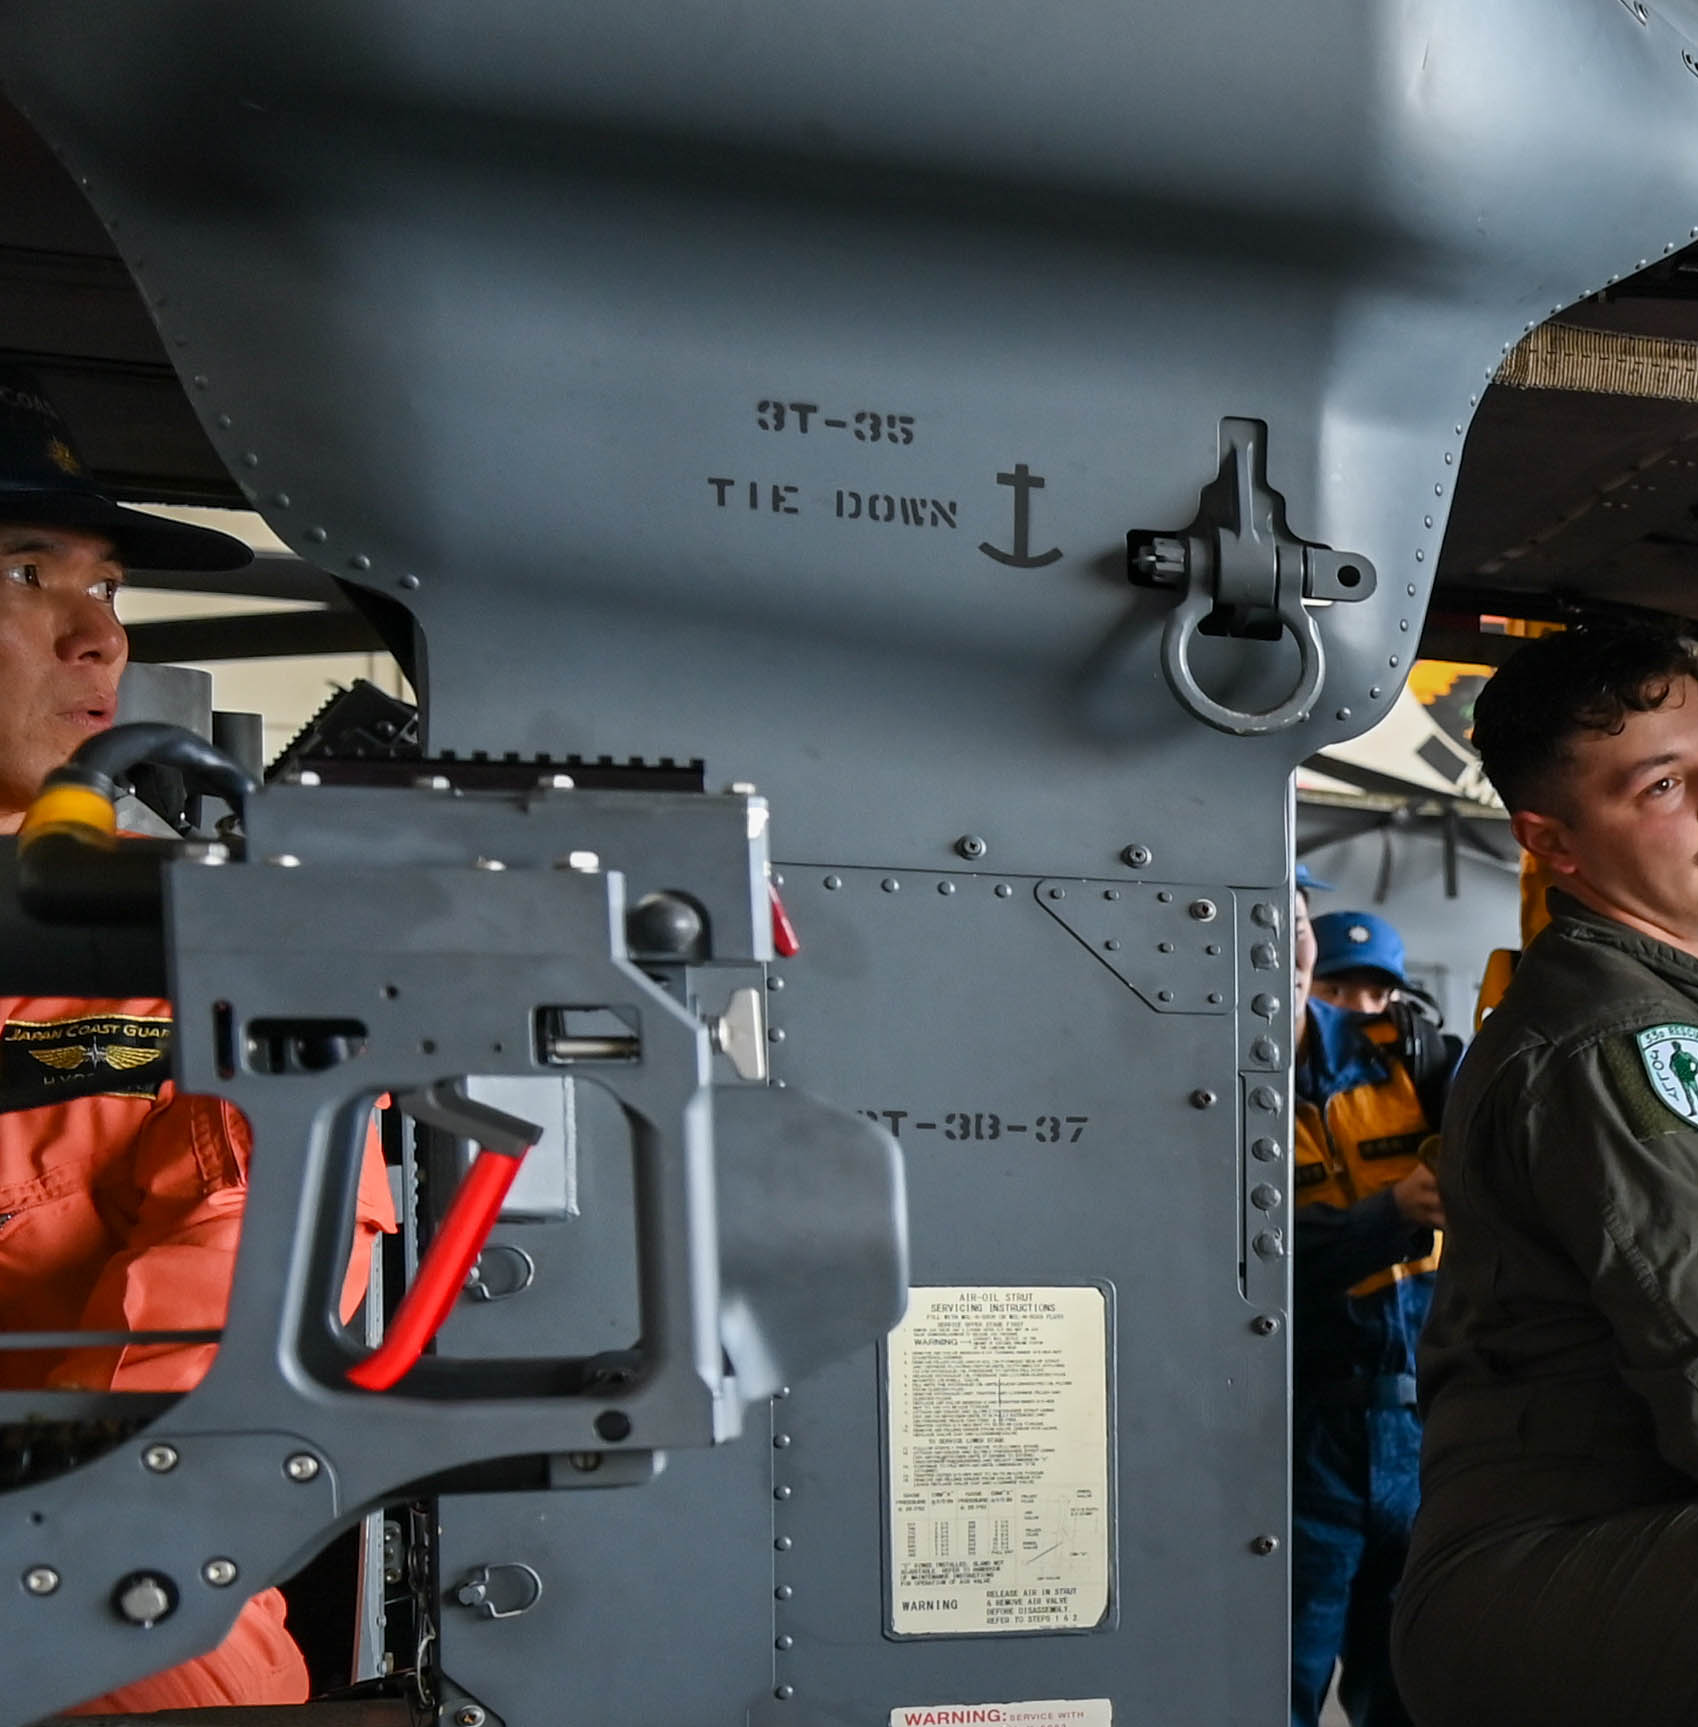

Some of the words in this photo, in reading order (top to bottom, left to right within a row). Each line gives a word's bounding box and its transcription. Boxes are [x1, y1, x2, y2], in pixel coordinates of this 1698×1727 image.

[757, 400, 915, 445] 3T-35
[707, 477, 799, 514] TIE
[836, 490, 957, 528] DOWN
[5, 1027, 62, 1041] JAPAN
[66, 1024, 121, 1038] COAST
[123, 1024, 171, 1038] GUAR
[959, 1293, 999, 1302] AIR-OIL
[1005, 1293, 1033, 1302] STRUT
[931, 1304, 982, 1312] SERVICING
[989, 1304, 1056, 1312] INSTRUCTIONS
[986, 1590, 1017, 1598] RELEASE
[902, 1599, 958, 1612] WARNING
[904, 1709, 1007, 1726] WARNING:
[1010, 1712, 1056, 1722] SERVICE
[1058, 1711, 1084, 1720] WITH
